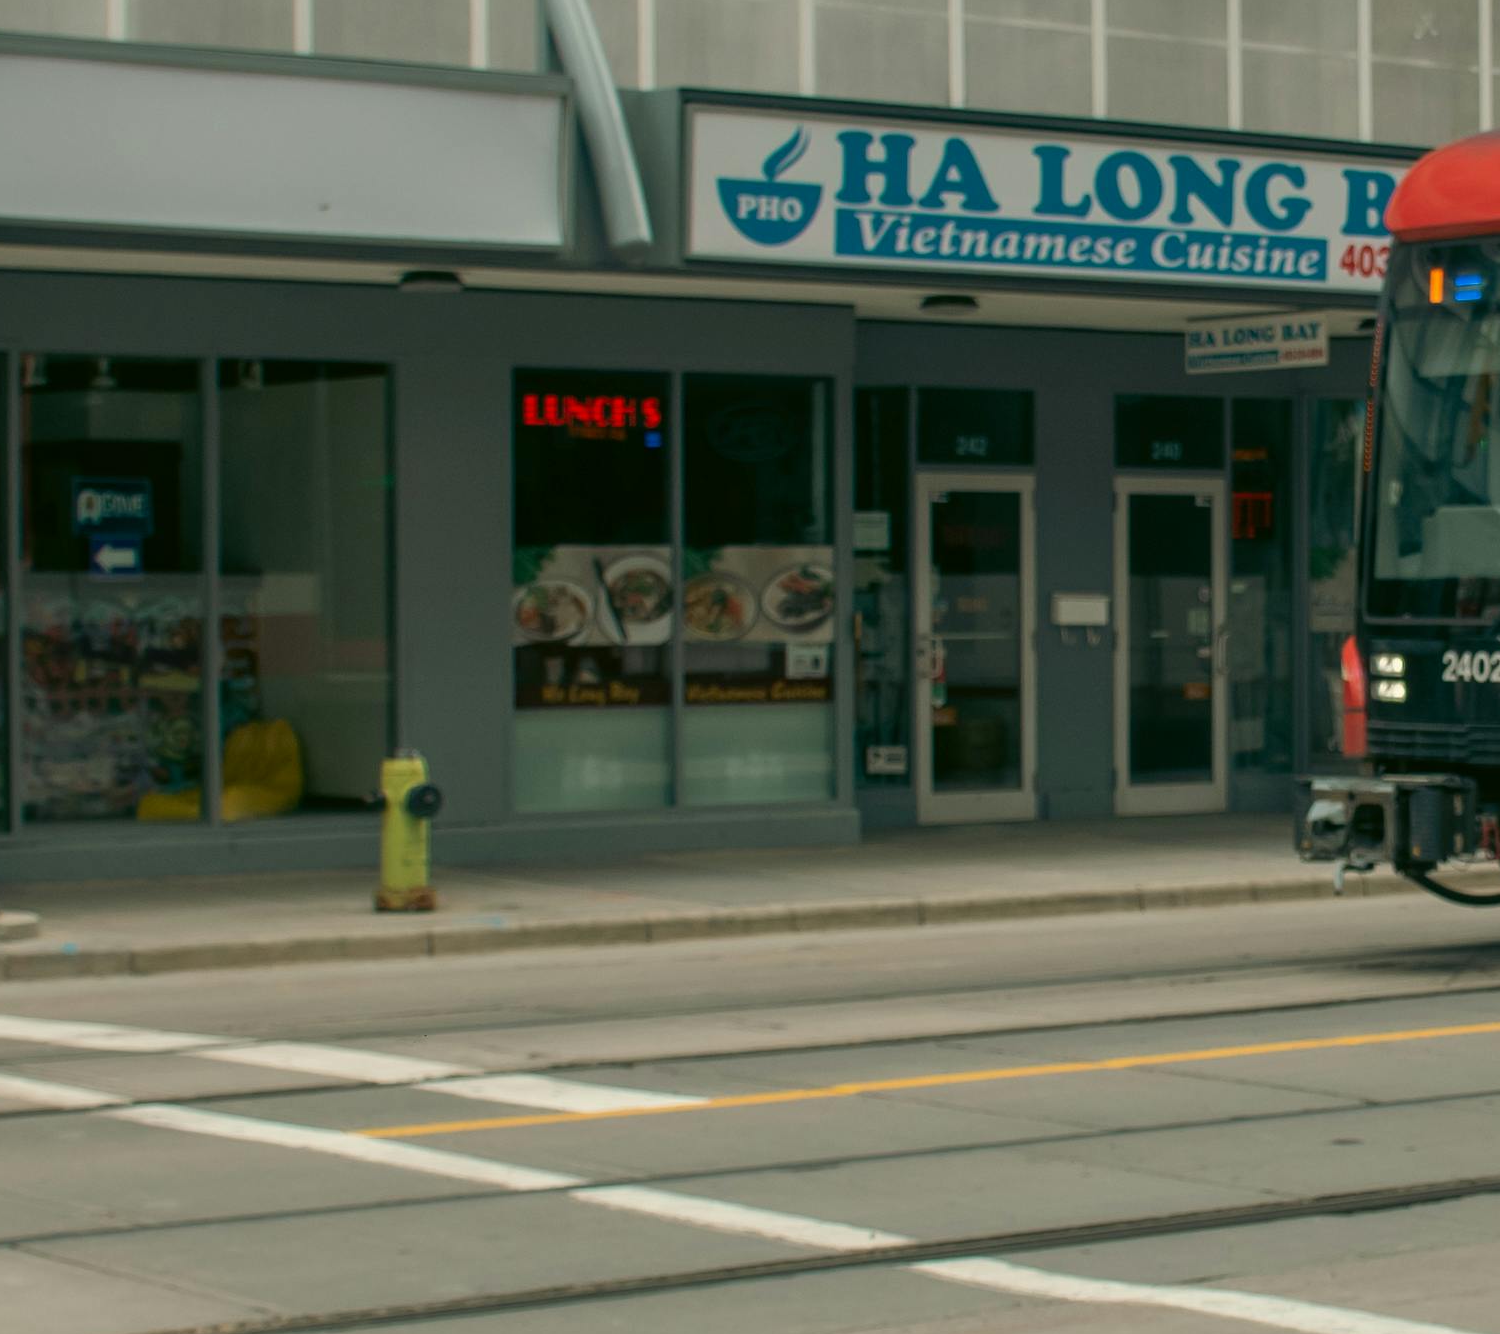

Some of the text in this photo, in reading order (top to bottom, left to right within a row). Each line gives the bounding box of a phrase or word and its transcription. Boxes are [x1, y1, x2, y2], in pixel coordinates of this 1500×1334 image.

[835, 130, 1000, 214] HA
[1032, 144, 1313, 233] LONG
[737, 193, 803, 222] PHO
[854, 211, 1321, 278] Vietnamese Cuisine
[1187, 320, 1320, 347] HA LONG BAY
[522, 394, 637, 427] LUNCH
